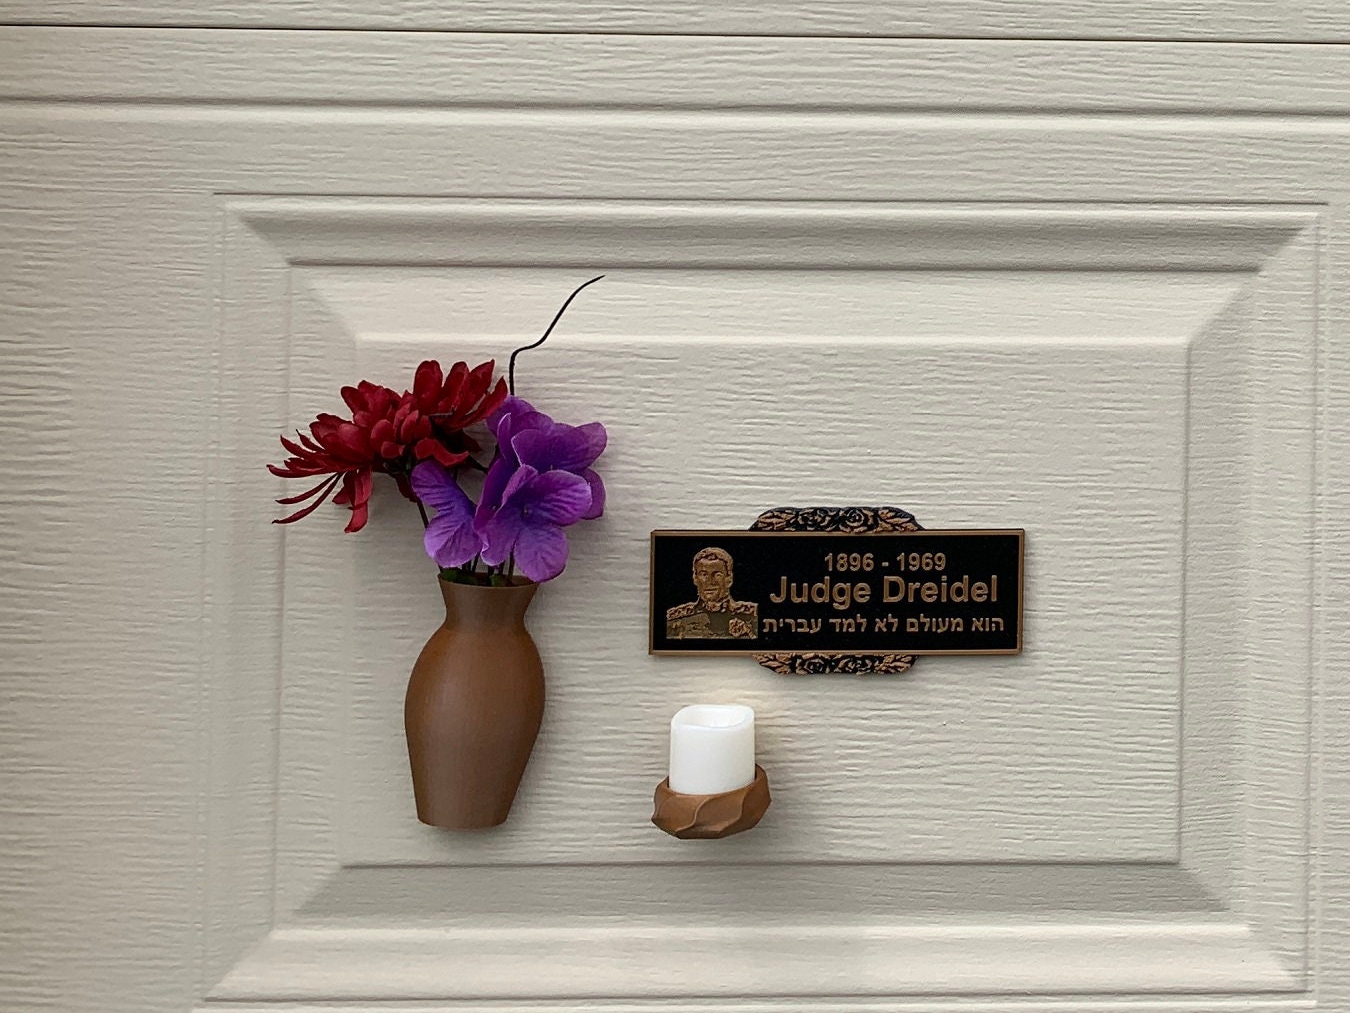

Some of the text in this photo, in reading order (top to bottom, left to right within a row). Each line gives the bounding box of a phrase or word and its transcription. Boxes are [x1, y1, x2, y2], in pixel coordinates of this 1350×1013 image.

[824, 553, 874, 572] 1896
[898, 553, 946, 571] 1969
[769, 575, 998, 610] Judge Dreidel
[762, 615, 1004, 634] הוא מעולם לא למד עברית
